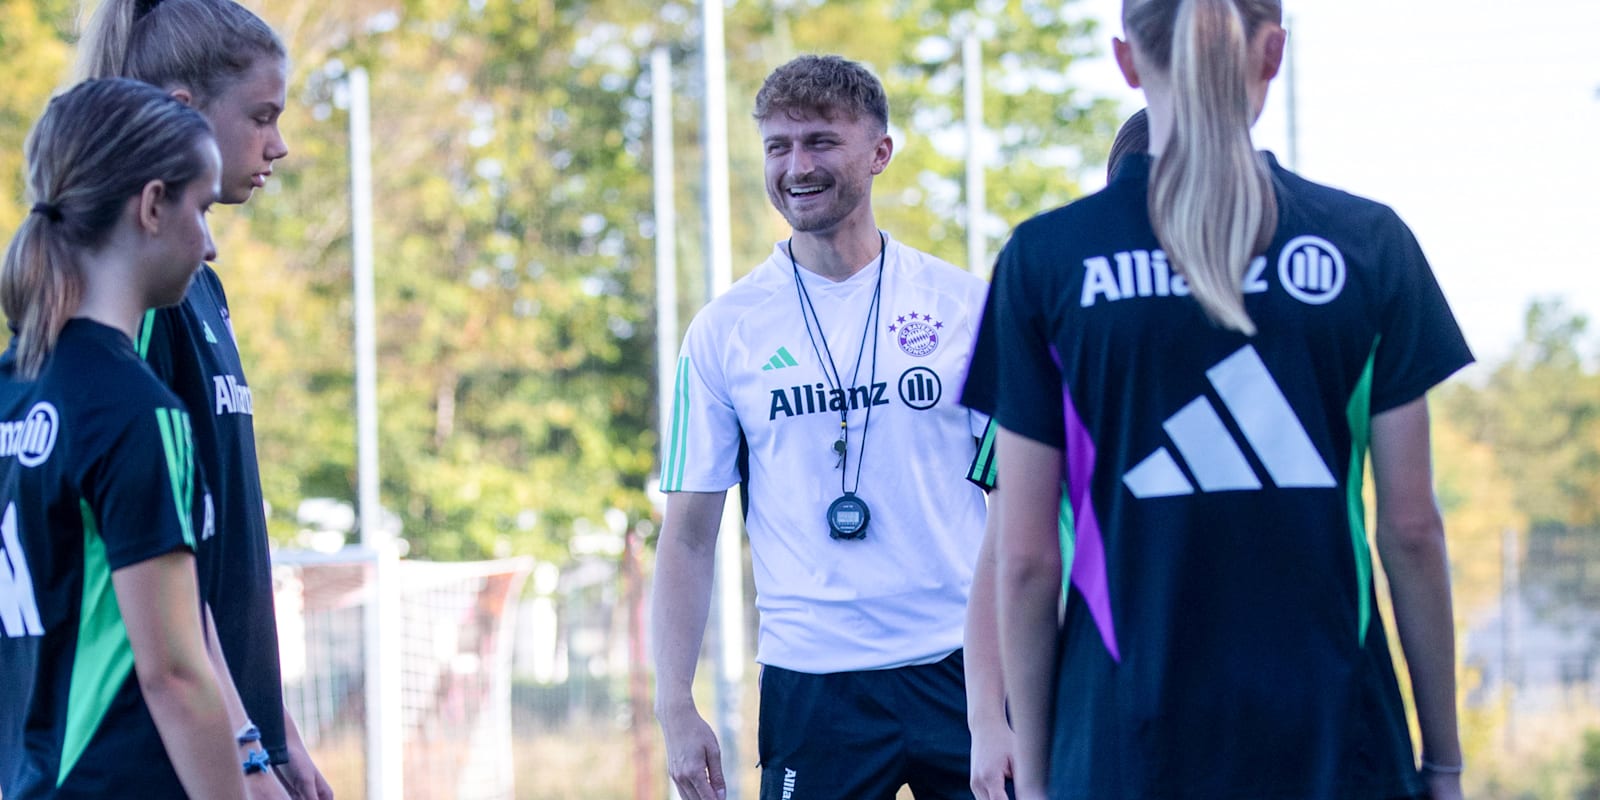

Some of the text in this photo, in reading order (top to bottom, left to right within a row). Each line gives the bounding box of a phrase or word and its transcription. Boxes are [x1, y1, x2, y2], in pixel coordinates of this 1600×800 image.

[1080, 249, 1268, 307] Alliaz
[769, 383, 889, 421] Allianz
[782, 767, 797, 800] Allia
